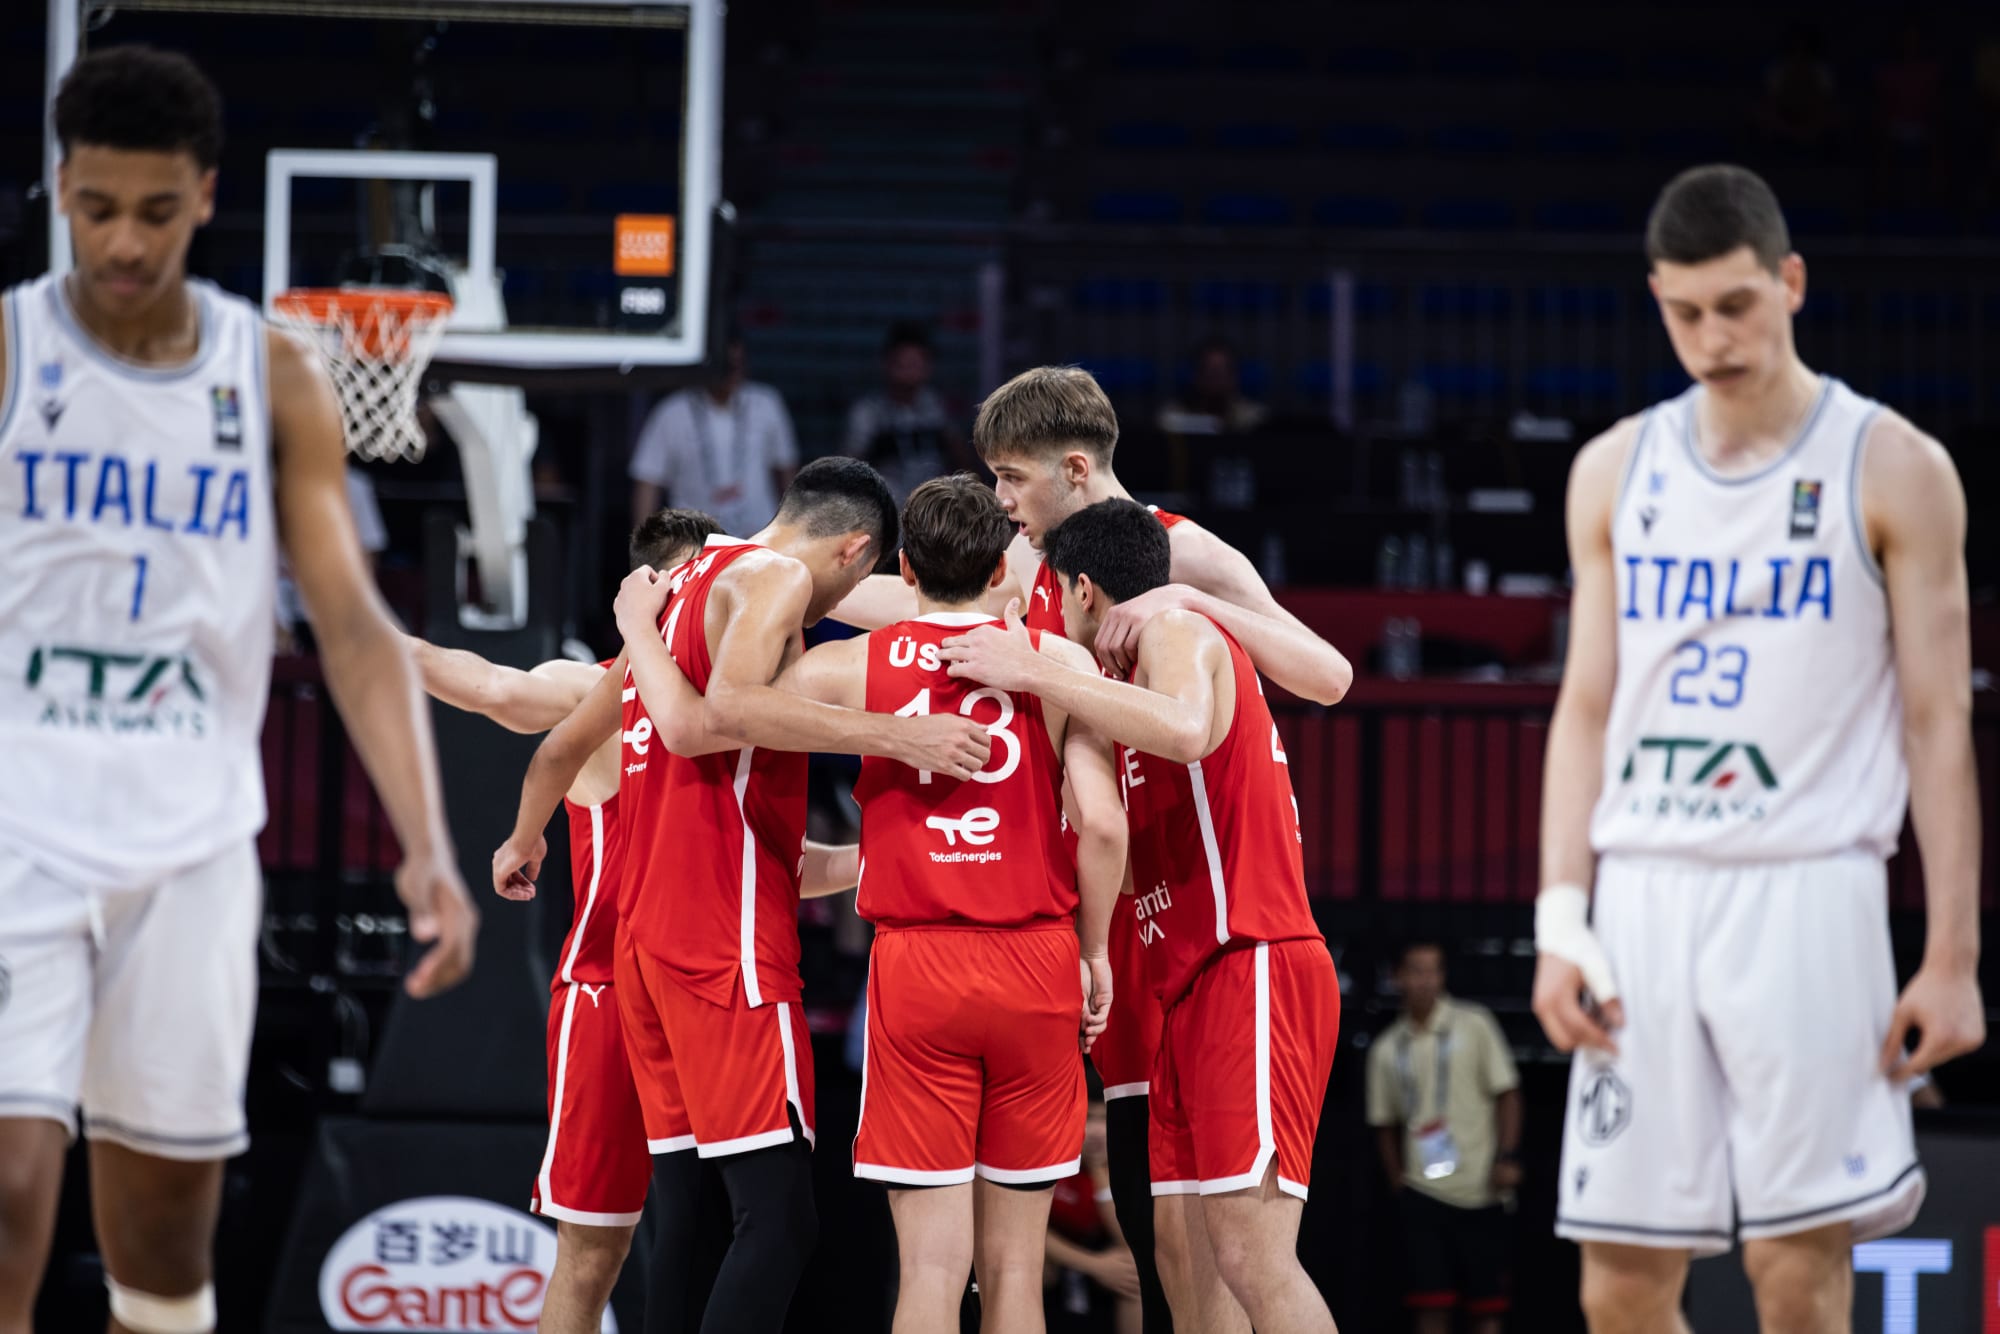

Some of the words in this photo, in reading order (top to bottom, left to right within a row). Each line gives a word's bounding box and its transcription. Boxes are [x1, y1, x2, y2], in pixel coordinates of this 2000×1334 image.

[16, 450, 250, 541] ITALIA
[130, 553, 149, 623] 1
[1624, 556, 1833, 620] ITALIA
[26, 646, 206, 703] ITA
[1670, 640, 1749, 707] 23
[1622, 738, 1779, 789] ITA
[928, 851, 1002, 864] TotalEnergies
[373, 1219, 537, 1267] 百岁山
[339, 1263, 547, 1330] Gante
